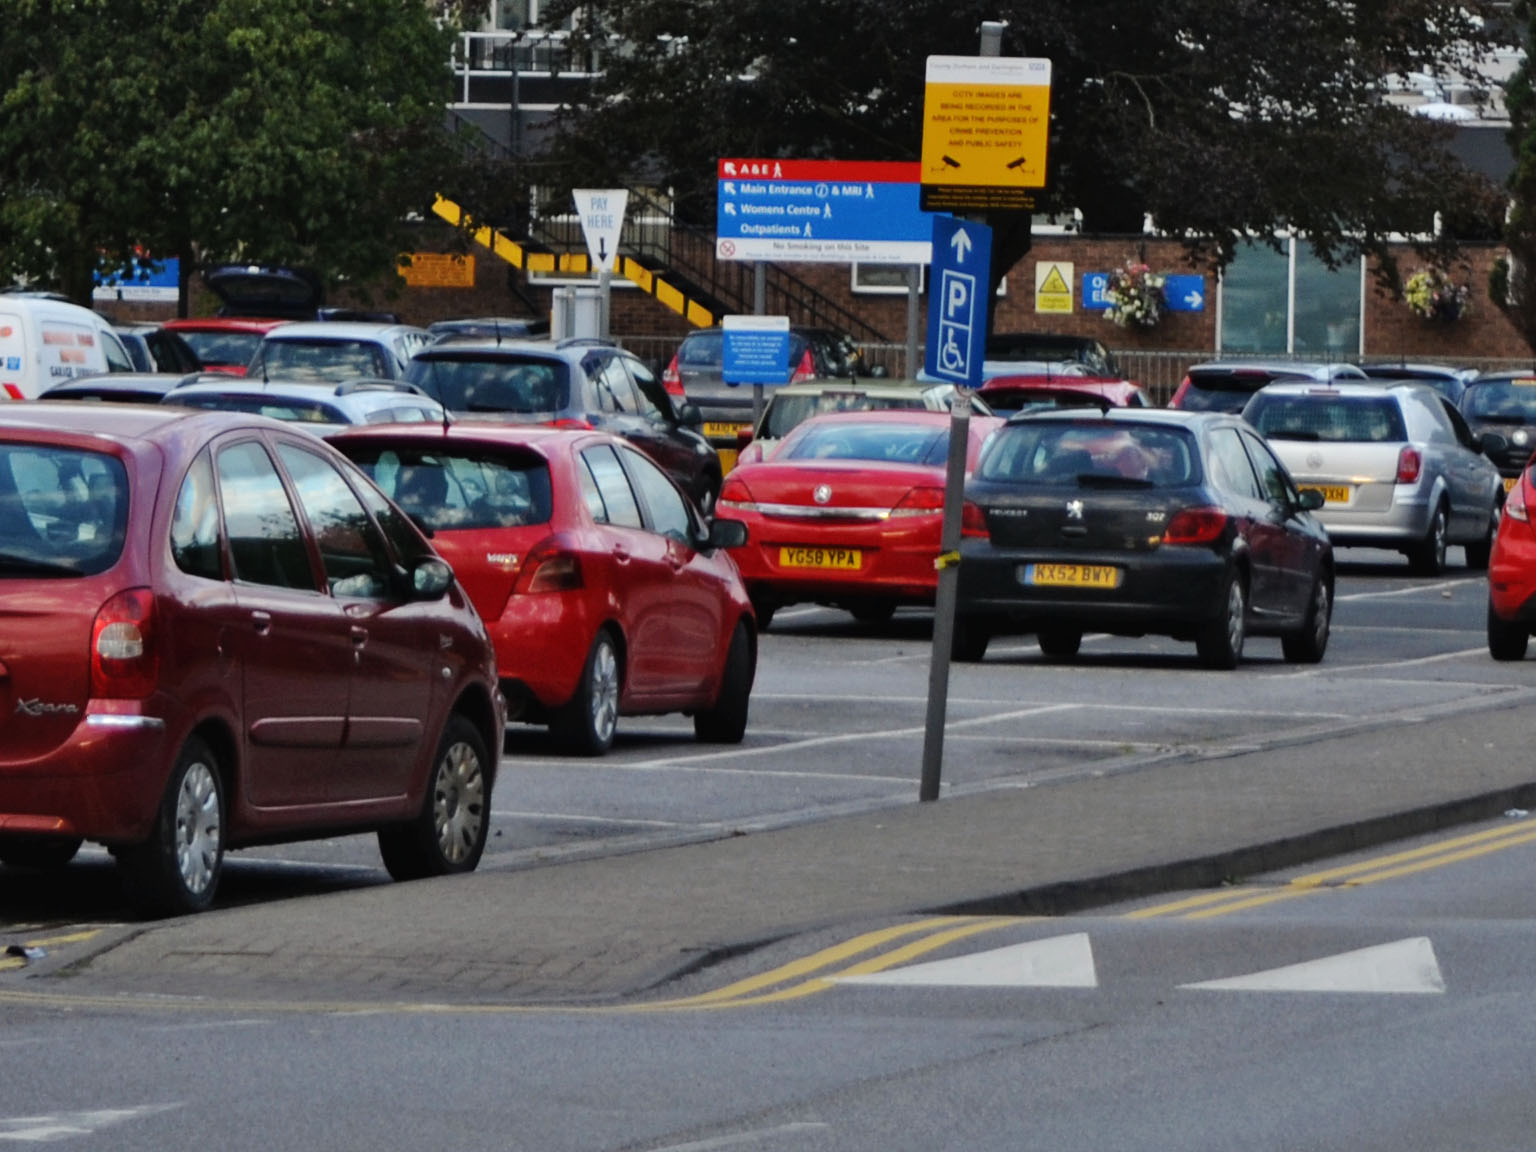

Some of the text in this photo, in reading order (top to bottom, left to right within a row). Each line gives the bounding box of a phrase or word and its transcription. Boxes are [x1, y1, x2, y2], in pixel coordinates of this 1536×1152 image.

[740, 183, 766, 194] Main
[769, 184, 813, 195] Entrance
[842, 186, 862, 196] MRI
[591, 196, 608, 209] PAY
[740, 204, 821, 215] Womens Centre
[587, 215, 614, 228] HERE
[740, 223, 800, 236] Outpatients
[773, 242, 785, 250] No
[787, 242, 825, 252] Smoking
[838, 243, 853, 251] this
[855, 244, 870, 252] Site
[948, 279, 967, 318] P
[989, 508, 1028, 517] PEUGEOT
[1146, 512, 1166, 521] 307
[786, 548, 855, 566] YG58 YPA
[1035, 565, 1113, 582] KX52 BWY
[14, 697, 79, 716] Xsara
